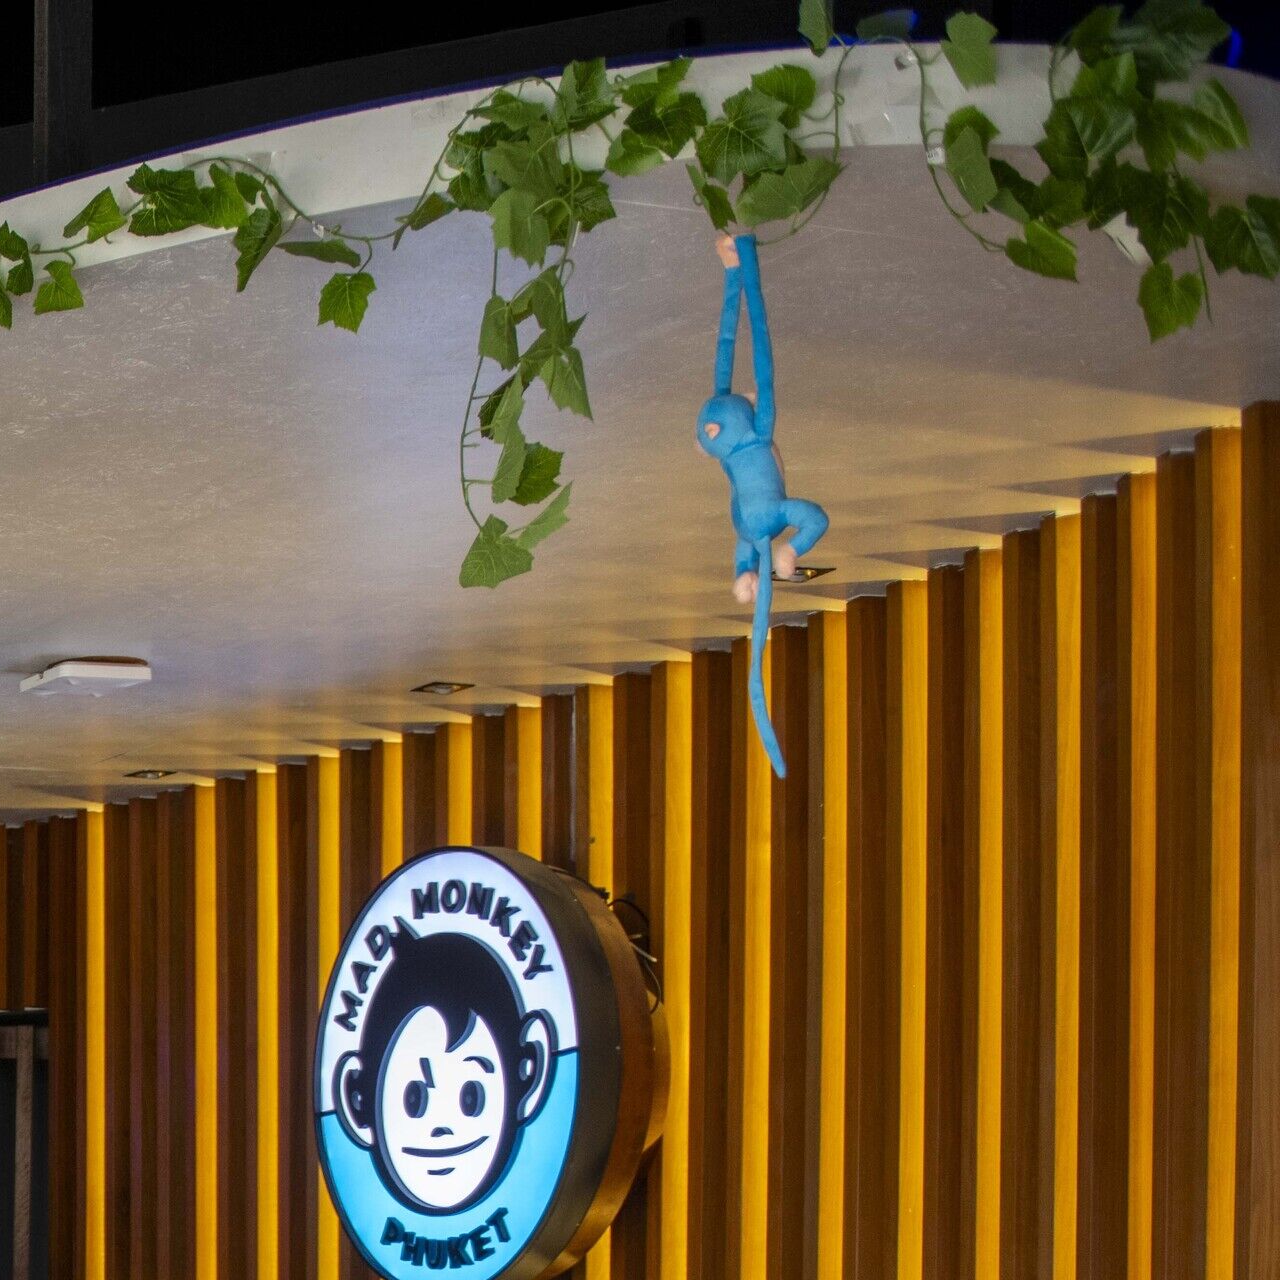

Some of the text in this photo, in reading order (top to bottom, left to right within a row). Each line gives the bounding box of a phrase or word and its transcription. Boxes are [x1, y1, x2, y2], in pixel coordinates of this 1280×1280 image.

[334, 879, 554, 1032] MAD MONKEY
[380, 1206, 511, 1269] PHUKET
